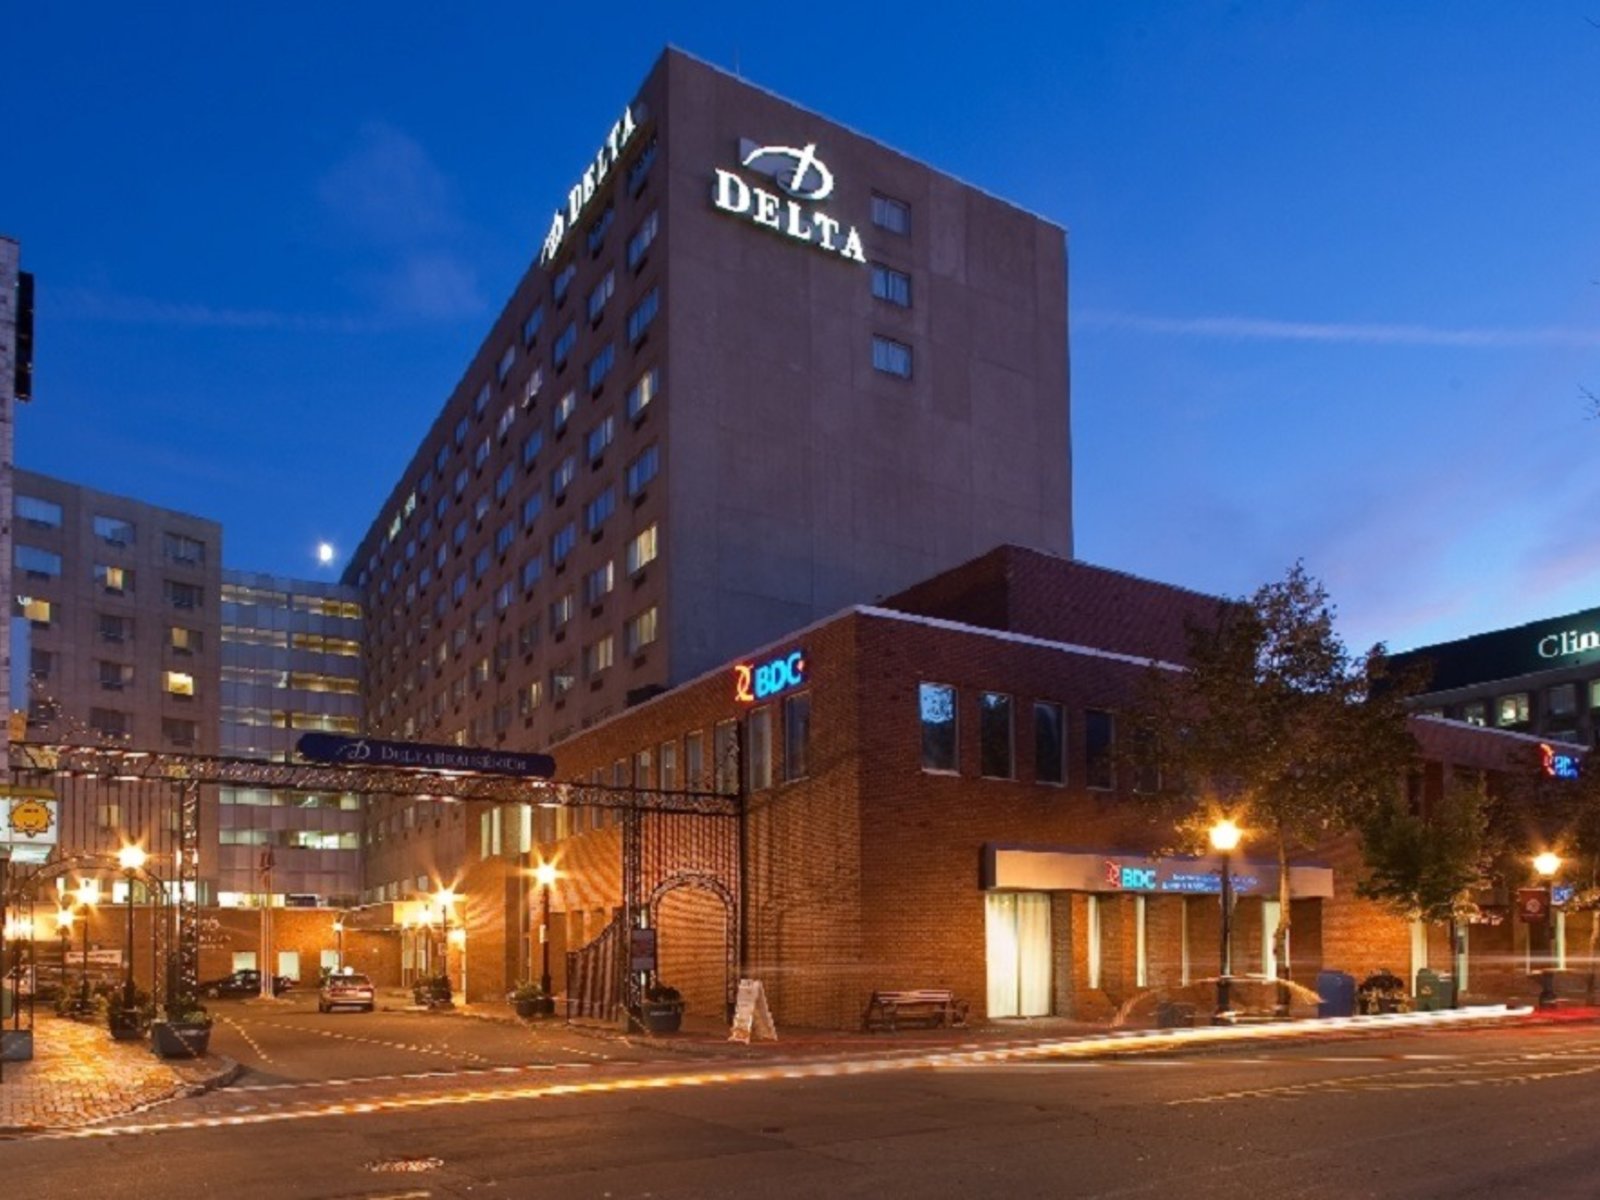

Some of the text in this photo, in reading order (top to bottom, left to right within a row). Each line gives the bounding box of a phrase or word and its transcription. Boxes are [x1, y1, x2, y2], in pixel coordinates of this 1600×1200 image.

[568, 105, 636, 227] DELTA
[714, 167, 867, 263] DELTA
[1538, 630, 1600, 658] Clin
[755, 652, 803, 698] BDC
[1122, 867, 1156, 889] BDC
